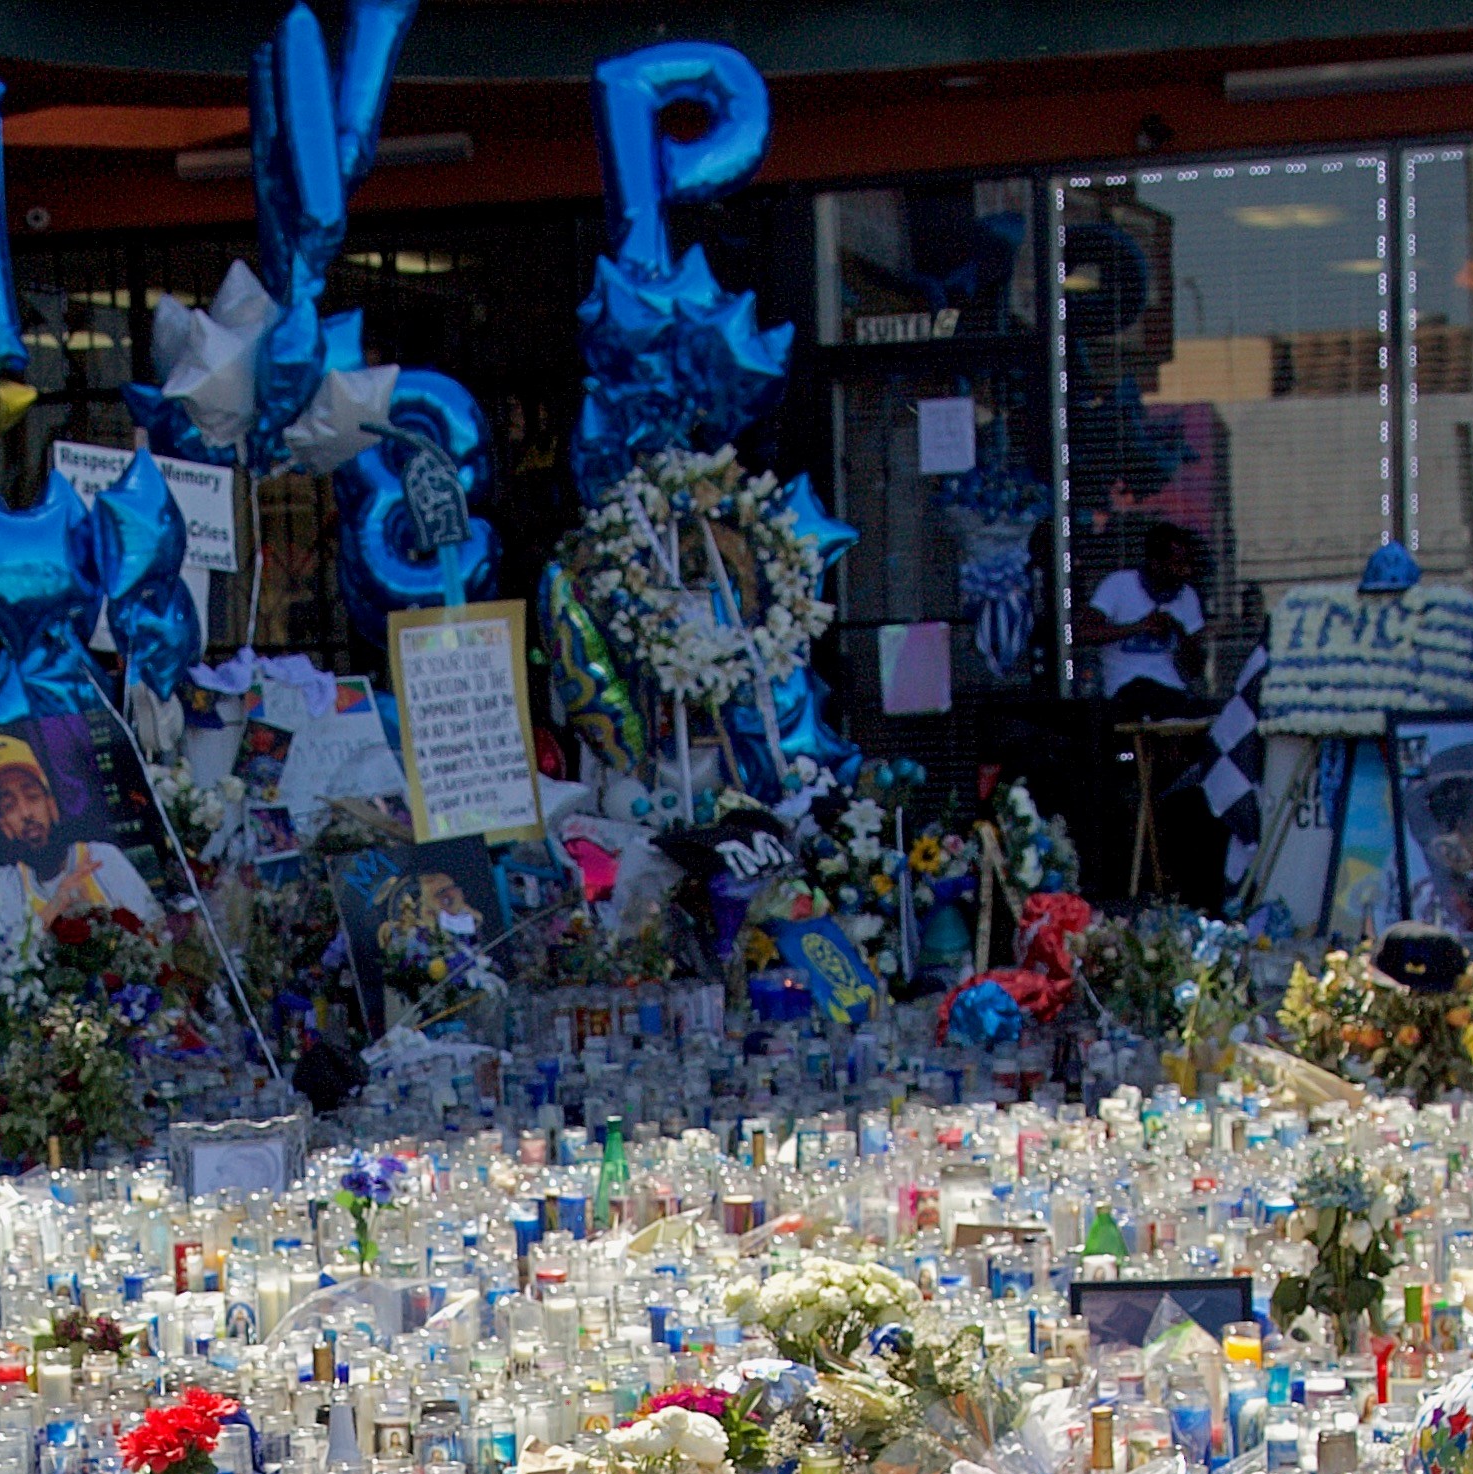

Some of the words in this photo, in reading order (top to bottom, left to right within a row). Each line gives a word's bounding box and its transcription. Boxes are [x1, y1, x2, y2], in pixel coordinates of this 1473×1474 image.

[59, 446, 126, 472] Respect
[162, 462, 222, 493] Memory
[187, 520, 229, 542] Cries
[188, 547, 232, 567] riend
[1287, 592, 1412, 652] TMC
